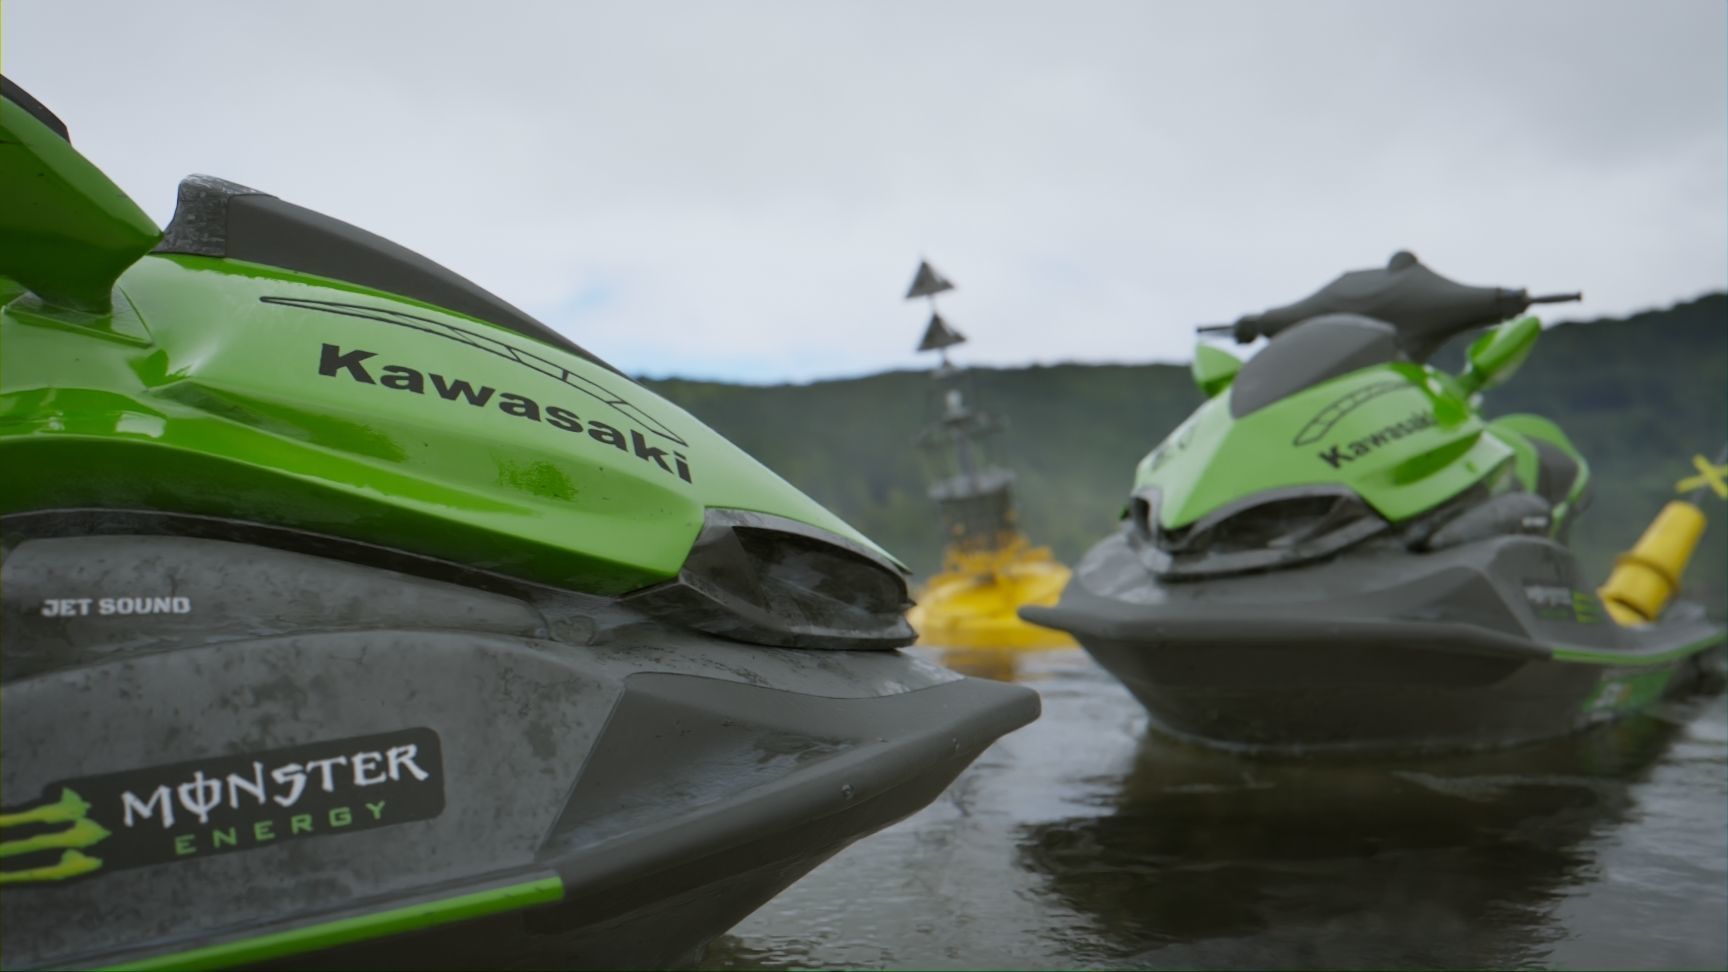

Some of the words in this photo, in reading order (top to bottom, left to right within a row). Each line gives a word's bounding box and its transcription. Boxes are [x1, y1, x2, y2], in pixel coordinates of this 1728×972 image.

[318, 343, 693, 484] Kawasaki
[41, 599, 92, 616] JET
[98, 597, 191, 614] SOUND
[121, 744, 429, 828] MONSTER
[174, 801, 386, 854] ENERGY
